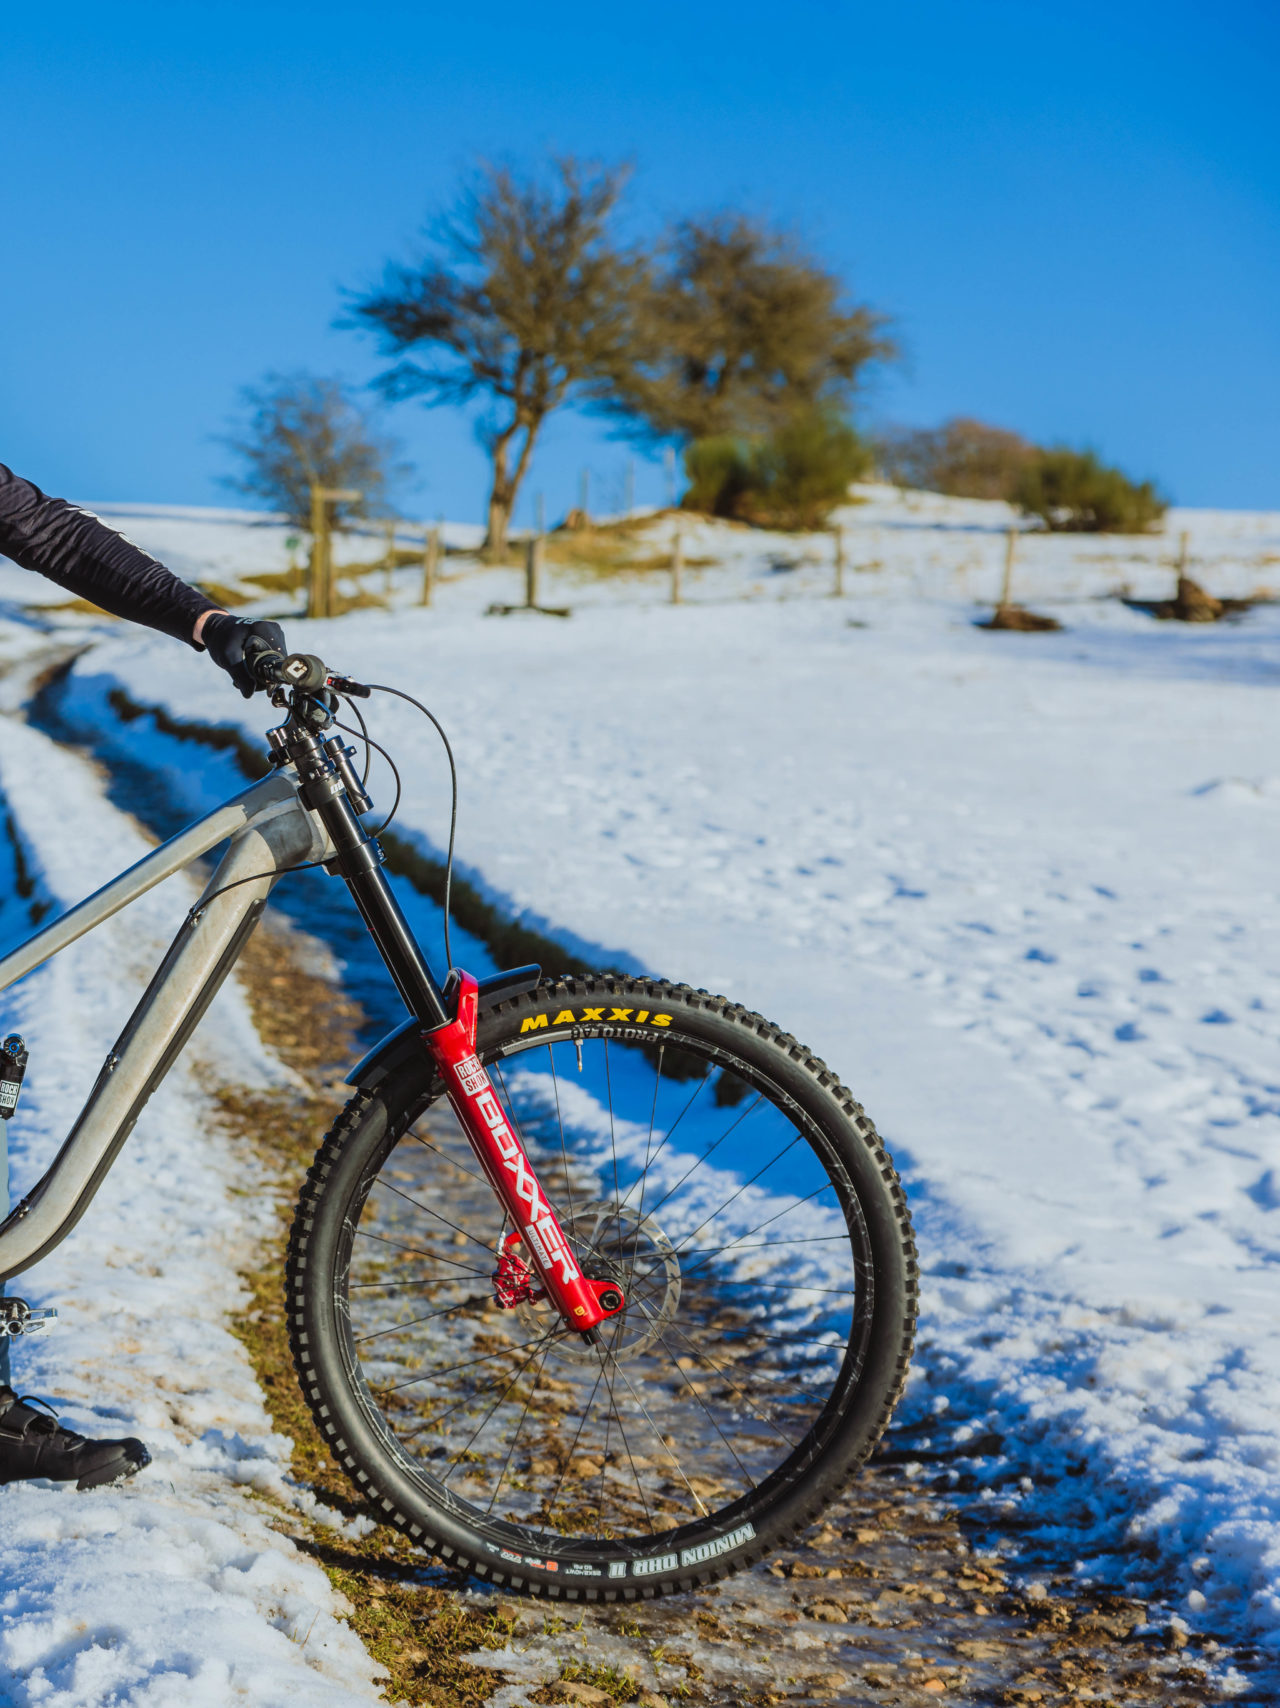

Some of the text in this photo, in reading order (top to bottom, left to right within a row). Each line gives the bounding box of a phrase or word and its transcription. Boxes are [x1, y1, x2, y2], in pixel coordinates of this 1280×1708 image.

[520, 1008, 674, 1034] MAXXIS
[457, 1056, 481, 1079] ROCK
[0, 1082, 19, 1094] ROCK
[476, 1091, 579, 1285] BOXXER
[528, 1229, 549, 1265] ULTIMATE
[608, 1521, 757, 1579] MINION DHR II
